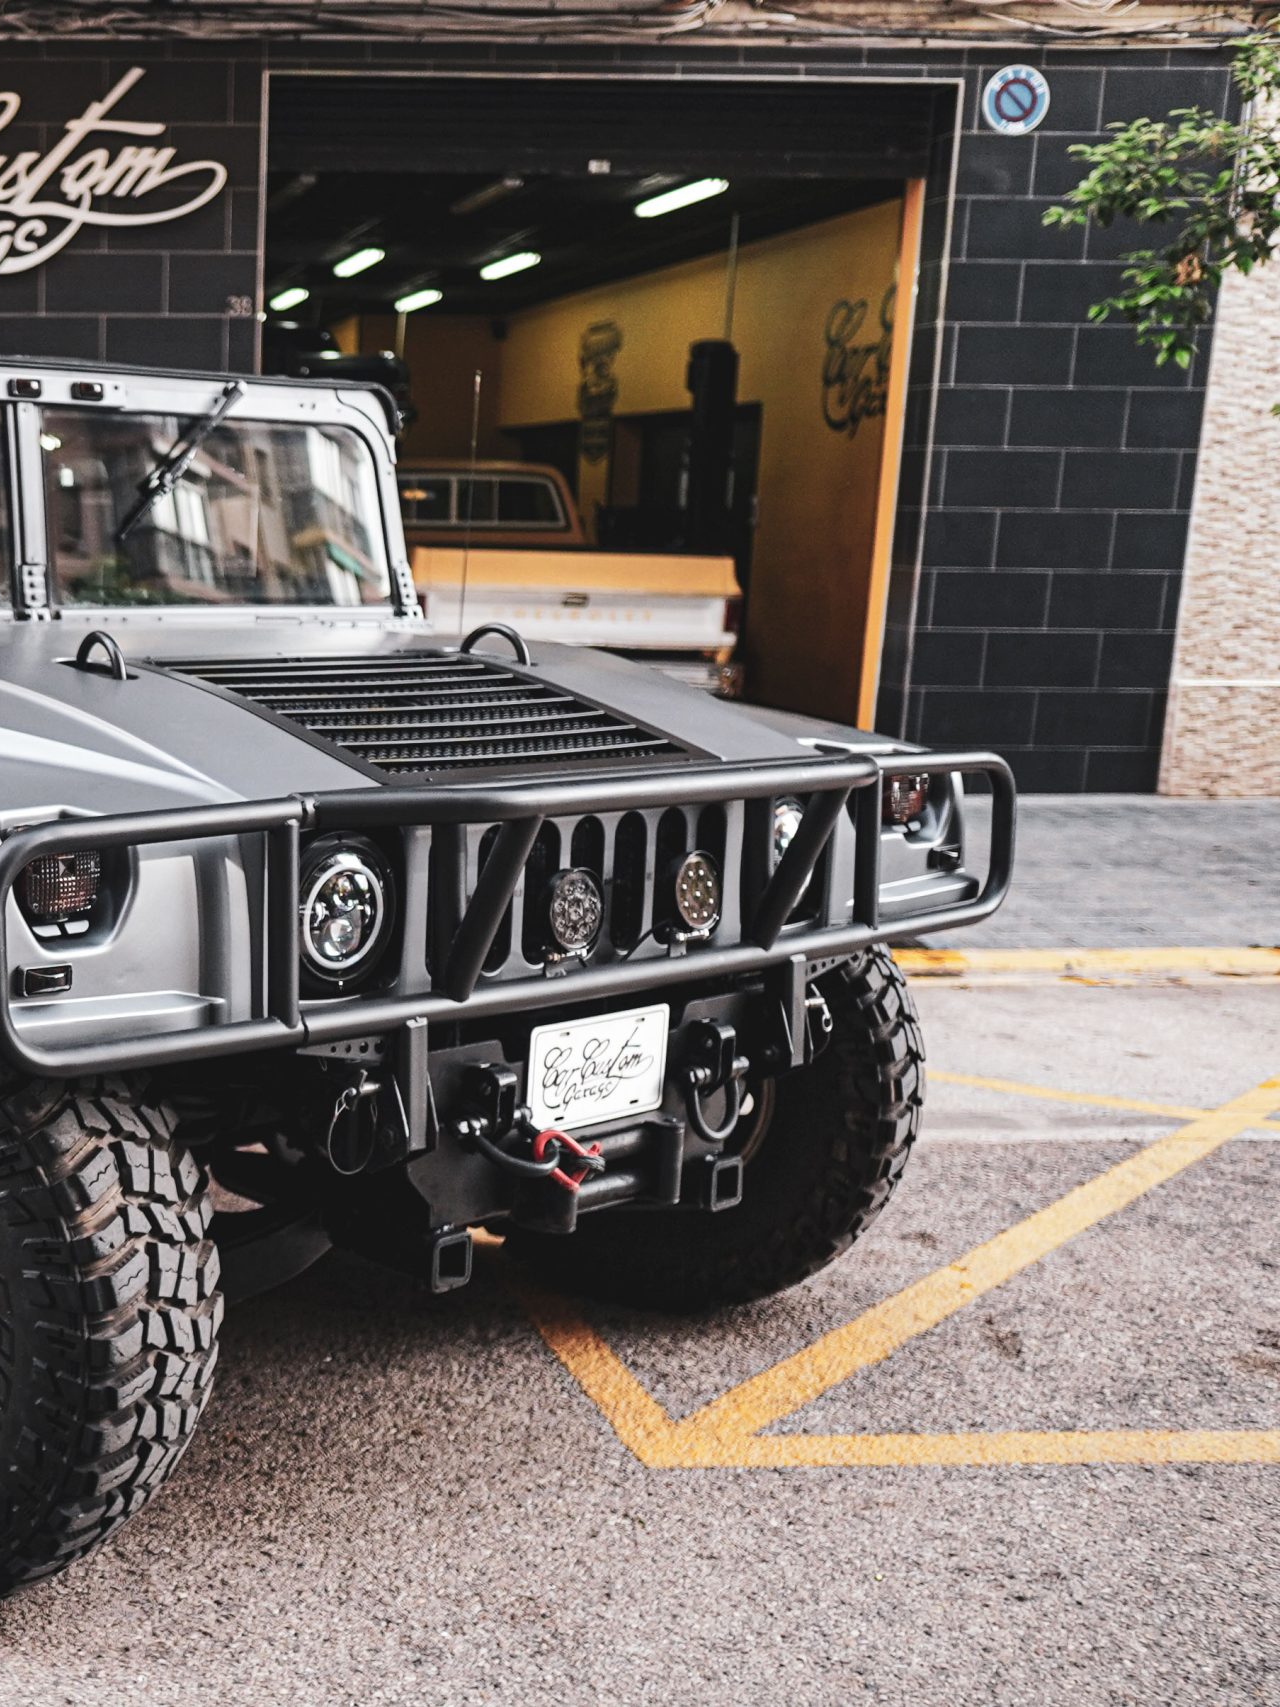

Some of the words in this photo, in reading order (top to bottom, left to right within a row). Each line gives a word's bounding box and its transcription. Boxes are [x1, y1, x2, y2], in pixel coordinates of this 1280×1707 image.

[542, 1047, 581, 1106] Car
[581, 1026, 655, 1081] Custom
[562, 1081, 614, 1112] Garage
